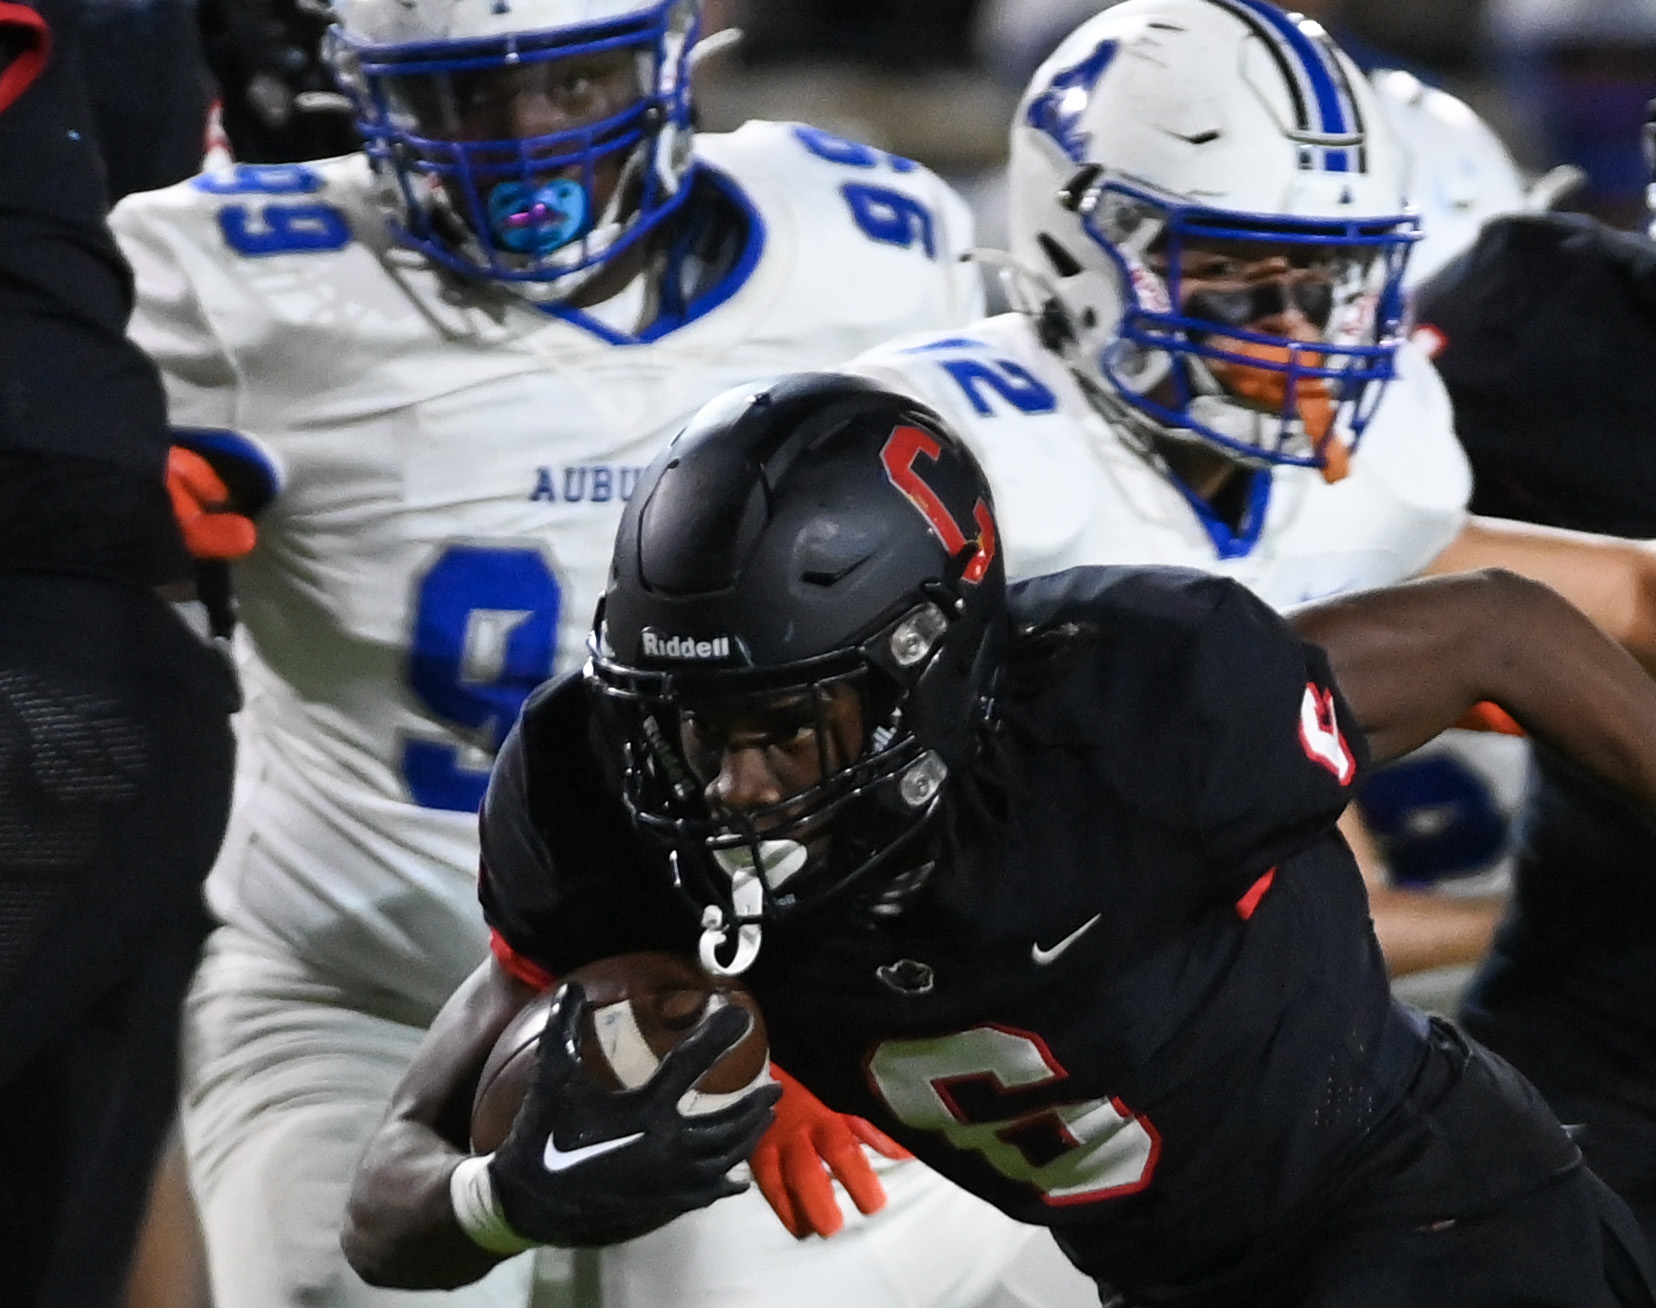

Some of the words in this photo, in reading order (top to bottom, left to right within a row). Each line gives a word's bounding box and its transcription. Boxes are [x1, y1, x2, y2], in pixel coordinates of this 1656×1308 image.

[898, 337, 1060, 418] 2
[641, 631, 731, 658] Riddell
[861, 1020, 1163, 1207] 6
